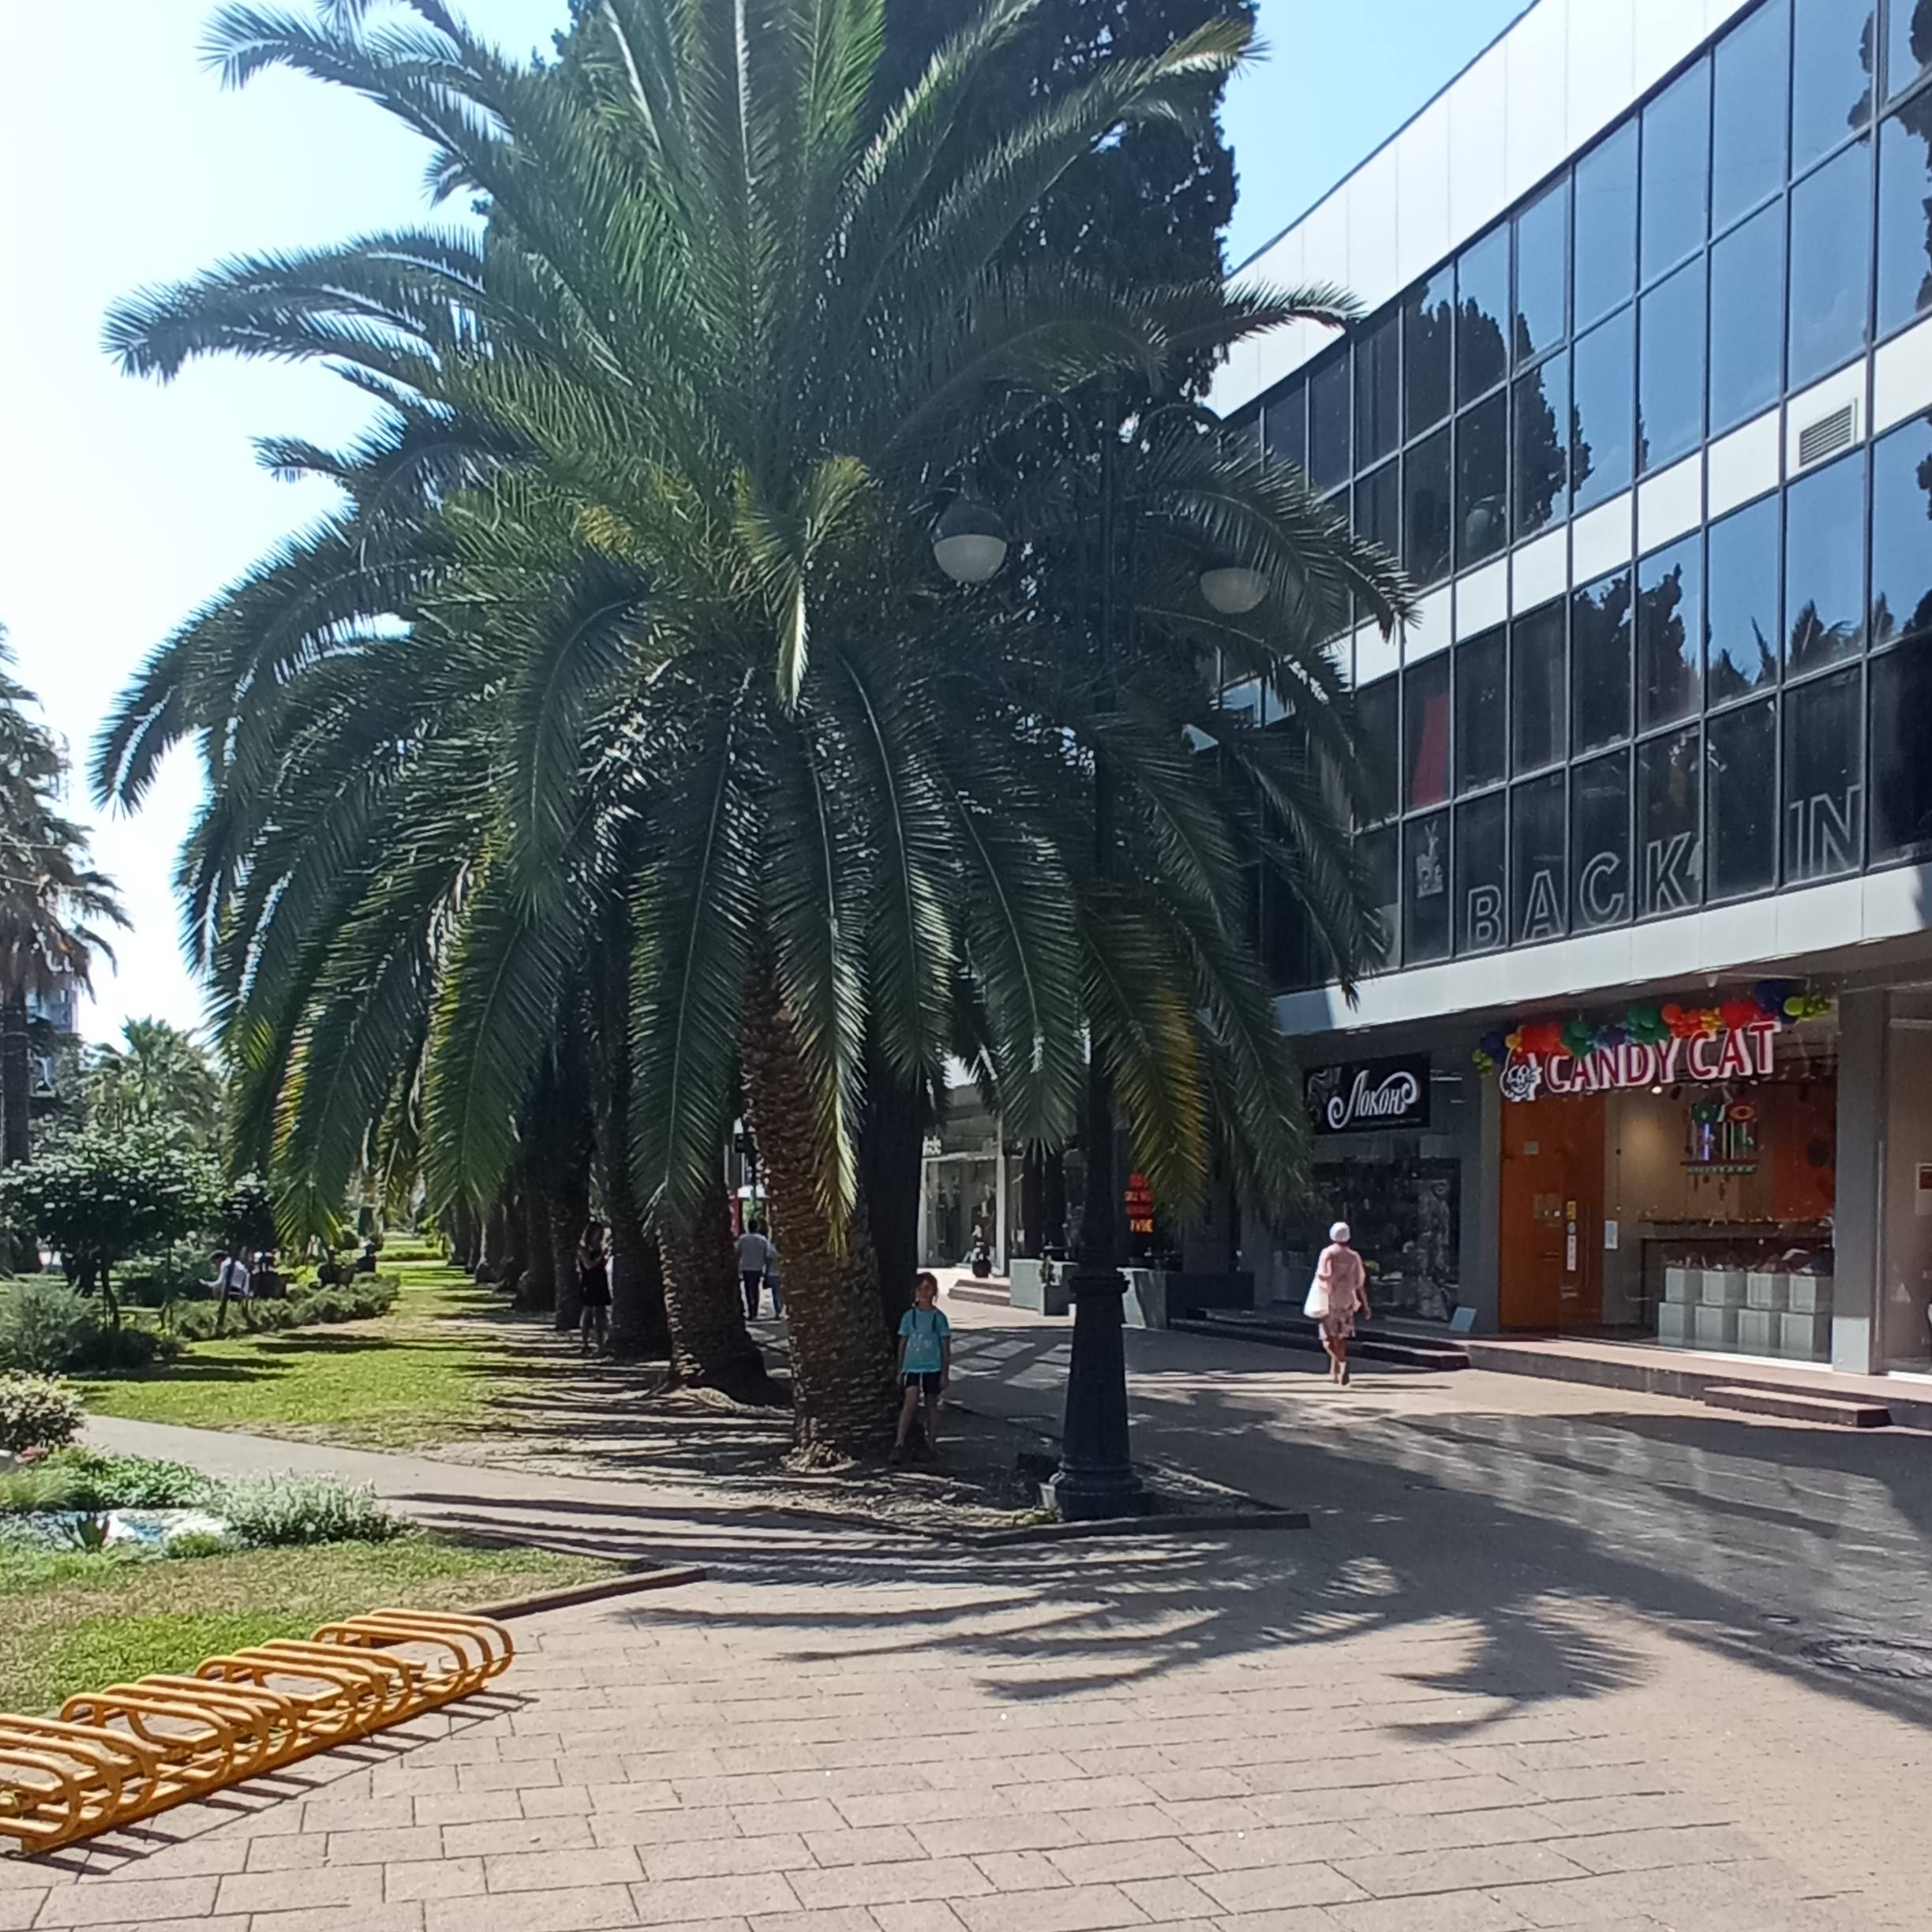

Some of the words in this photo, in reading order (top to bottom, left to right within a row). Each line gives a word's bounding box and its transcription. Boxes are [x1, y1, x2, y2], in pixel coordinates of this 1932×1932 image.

[1467, 831, 1691, 950] BACK
[1789, 786, 1860, 879] IN
[1544, 1035, 1681, 1093] CANDY
[1687, 1020, 1781, 1080] CAT
